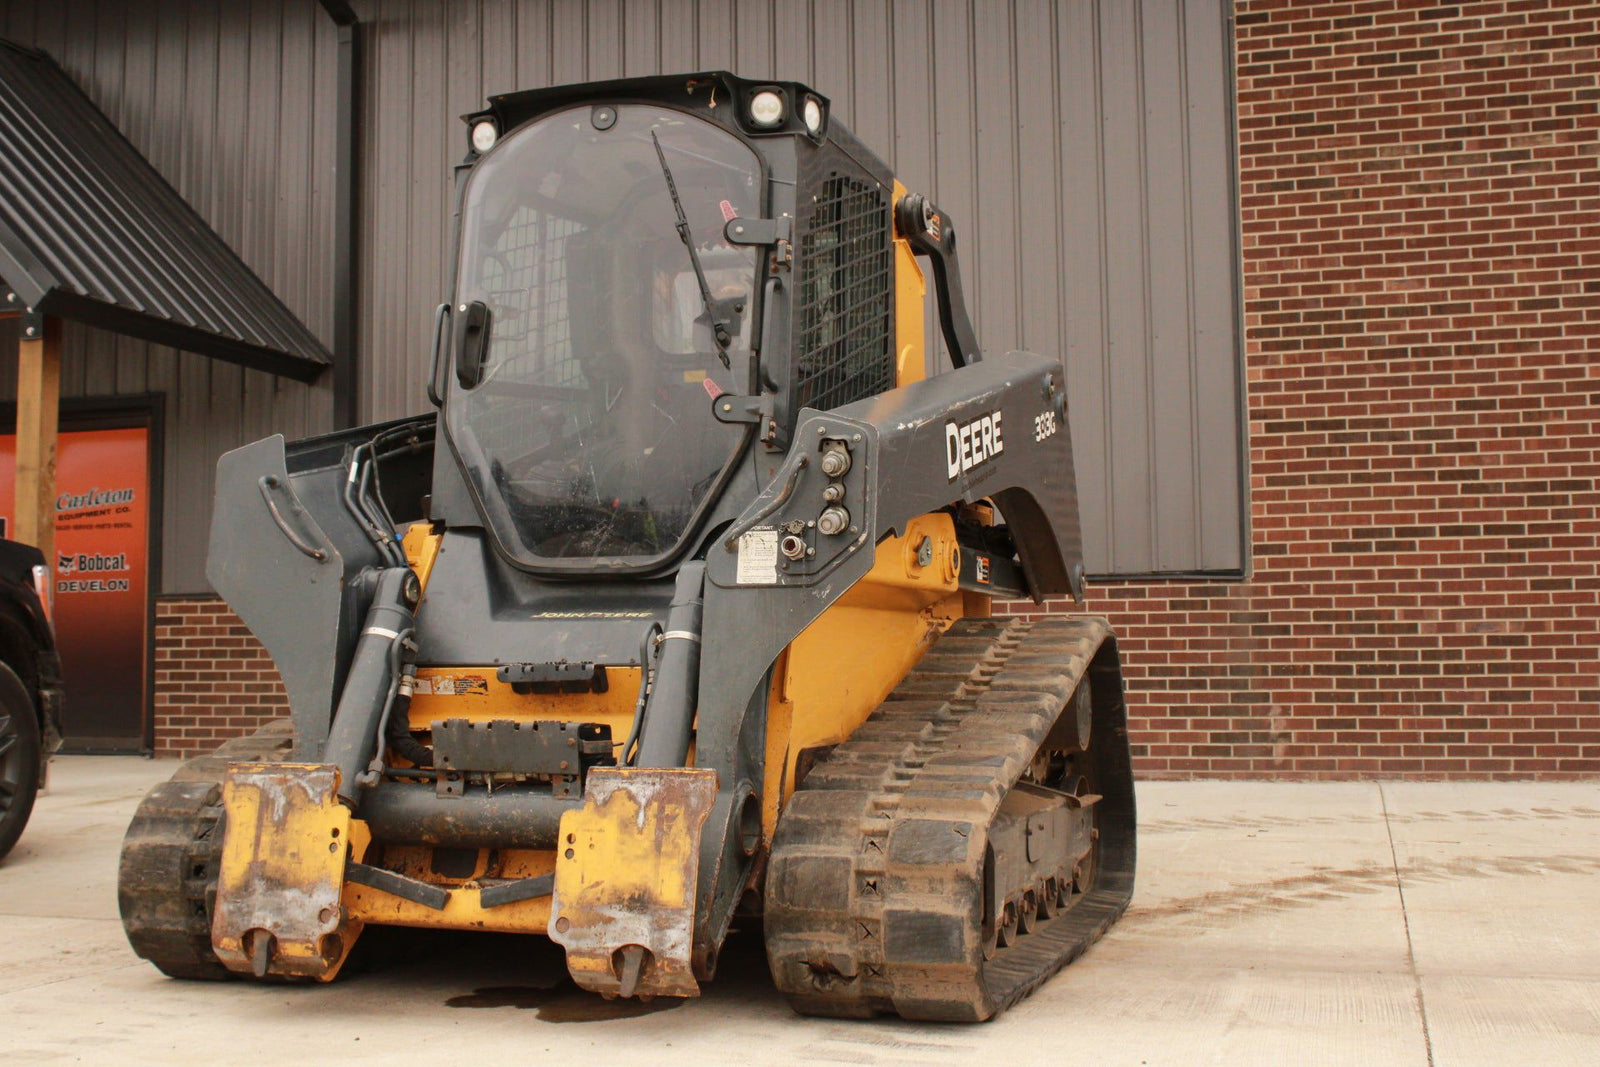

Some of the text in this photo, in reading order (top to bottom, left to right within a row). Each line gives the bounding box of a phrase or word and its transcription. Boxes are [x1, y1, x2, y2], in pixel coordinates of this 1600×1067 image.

[945, 411, 1004, 479] DEERE
[56, 488, 133, 511] Carleton
[58, 508, 111, 521] EQUIPMENT
[78, 554, 126, 571] Bobcat
[58, 580, 129, 592] DEVELON
